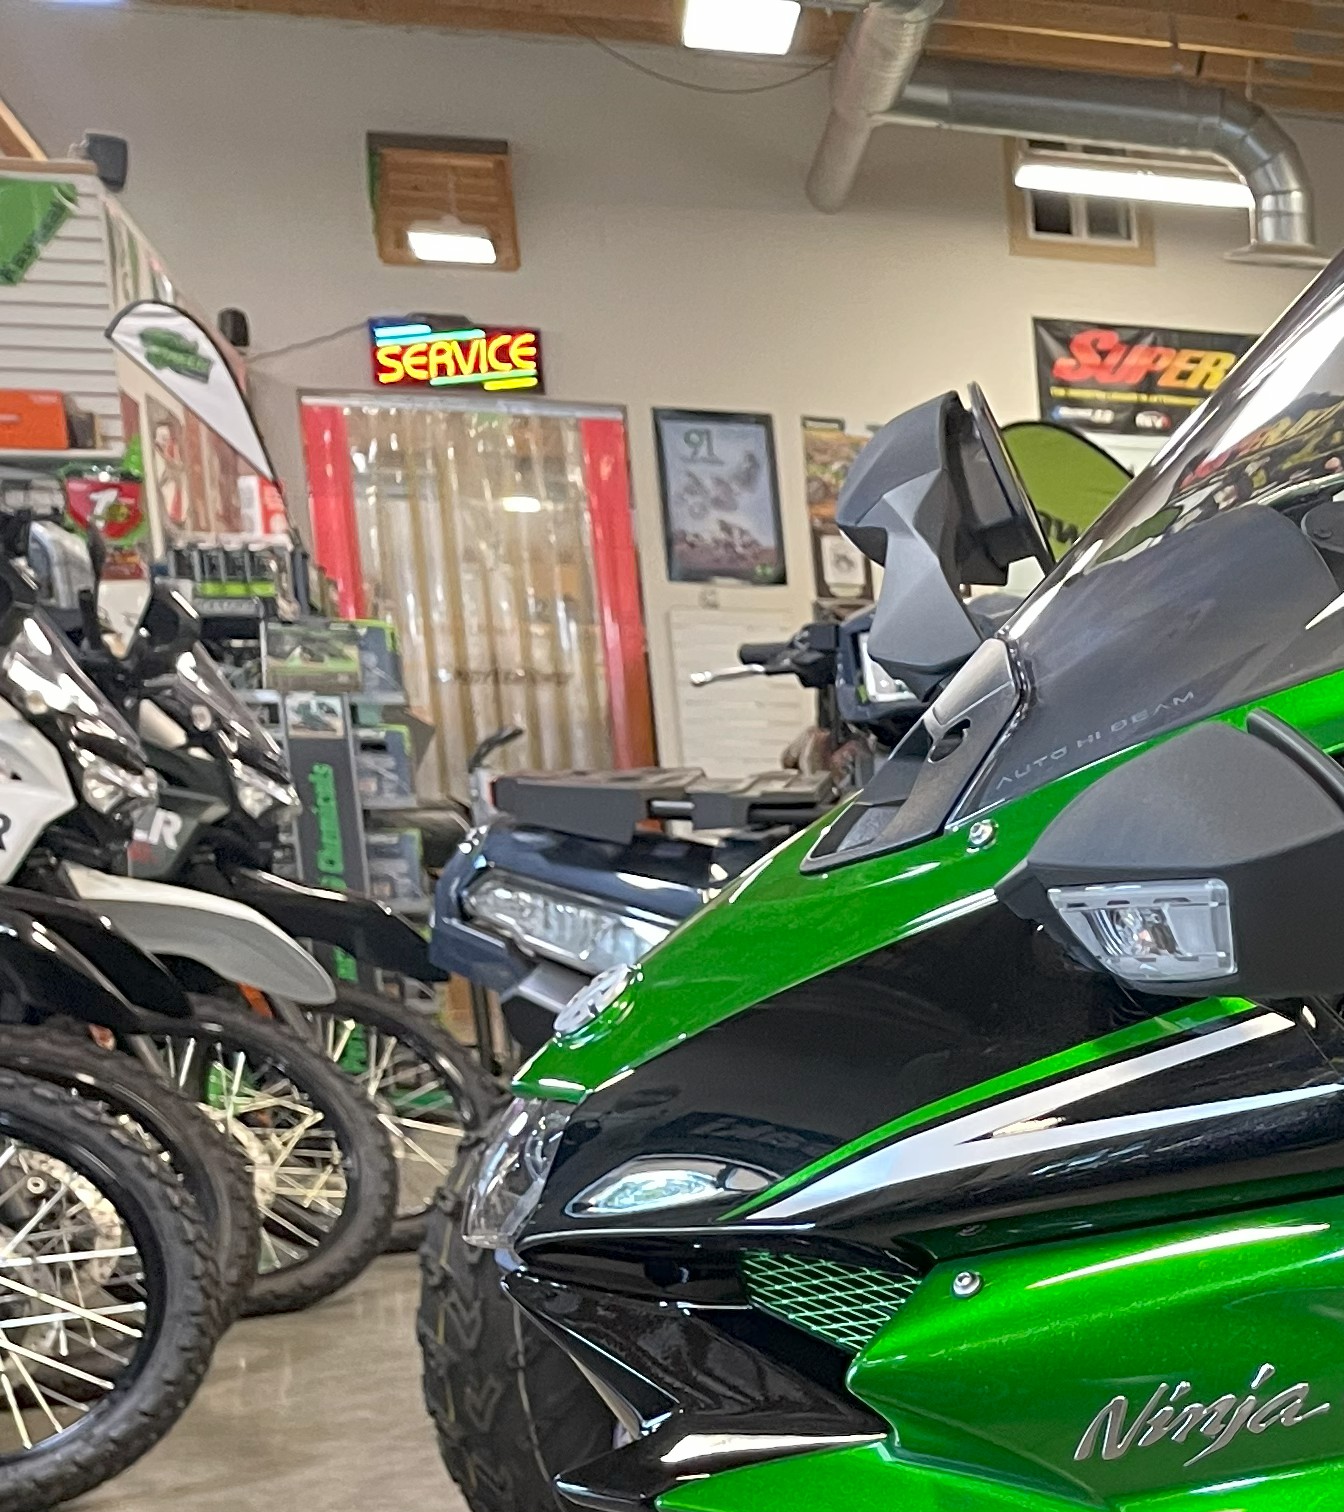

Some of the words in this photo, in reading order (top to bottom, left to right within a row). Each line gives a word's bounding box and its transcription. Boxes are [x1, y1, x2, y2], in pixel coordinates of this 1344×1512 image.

[376, 332, 537, 384] SERVICE
[1052, 329, 1238, 390] SUPER
[996, 746, 1068, 790] AUTO
[1077, 731, 1101, 748] HI
[1111, 691, 1194, 732] BEAM
[1073, 1362, 1331, 1467] Ninja
